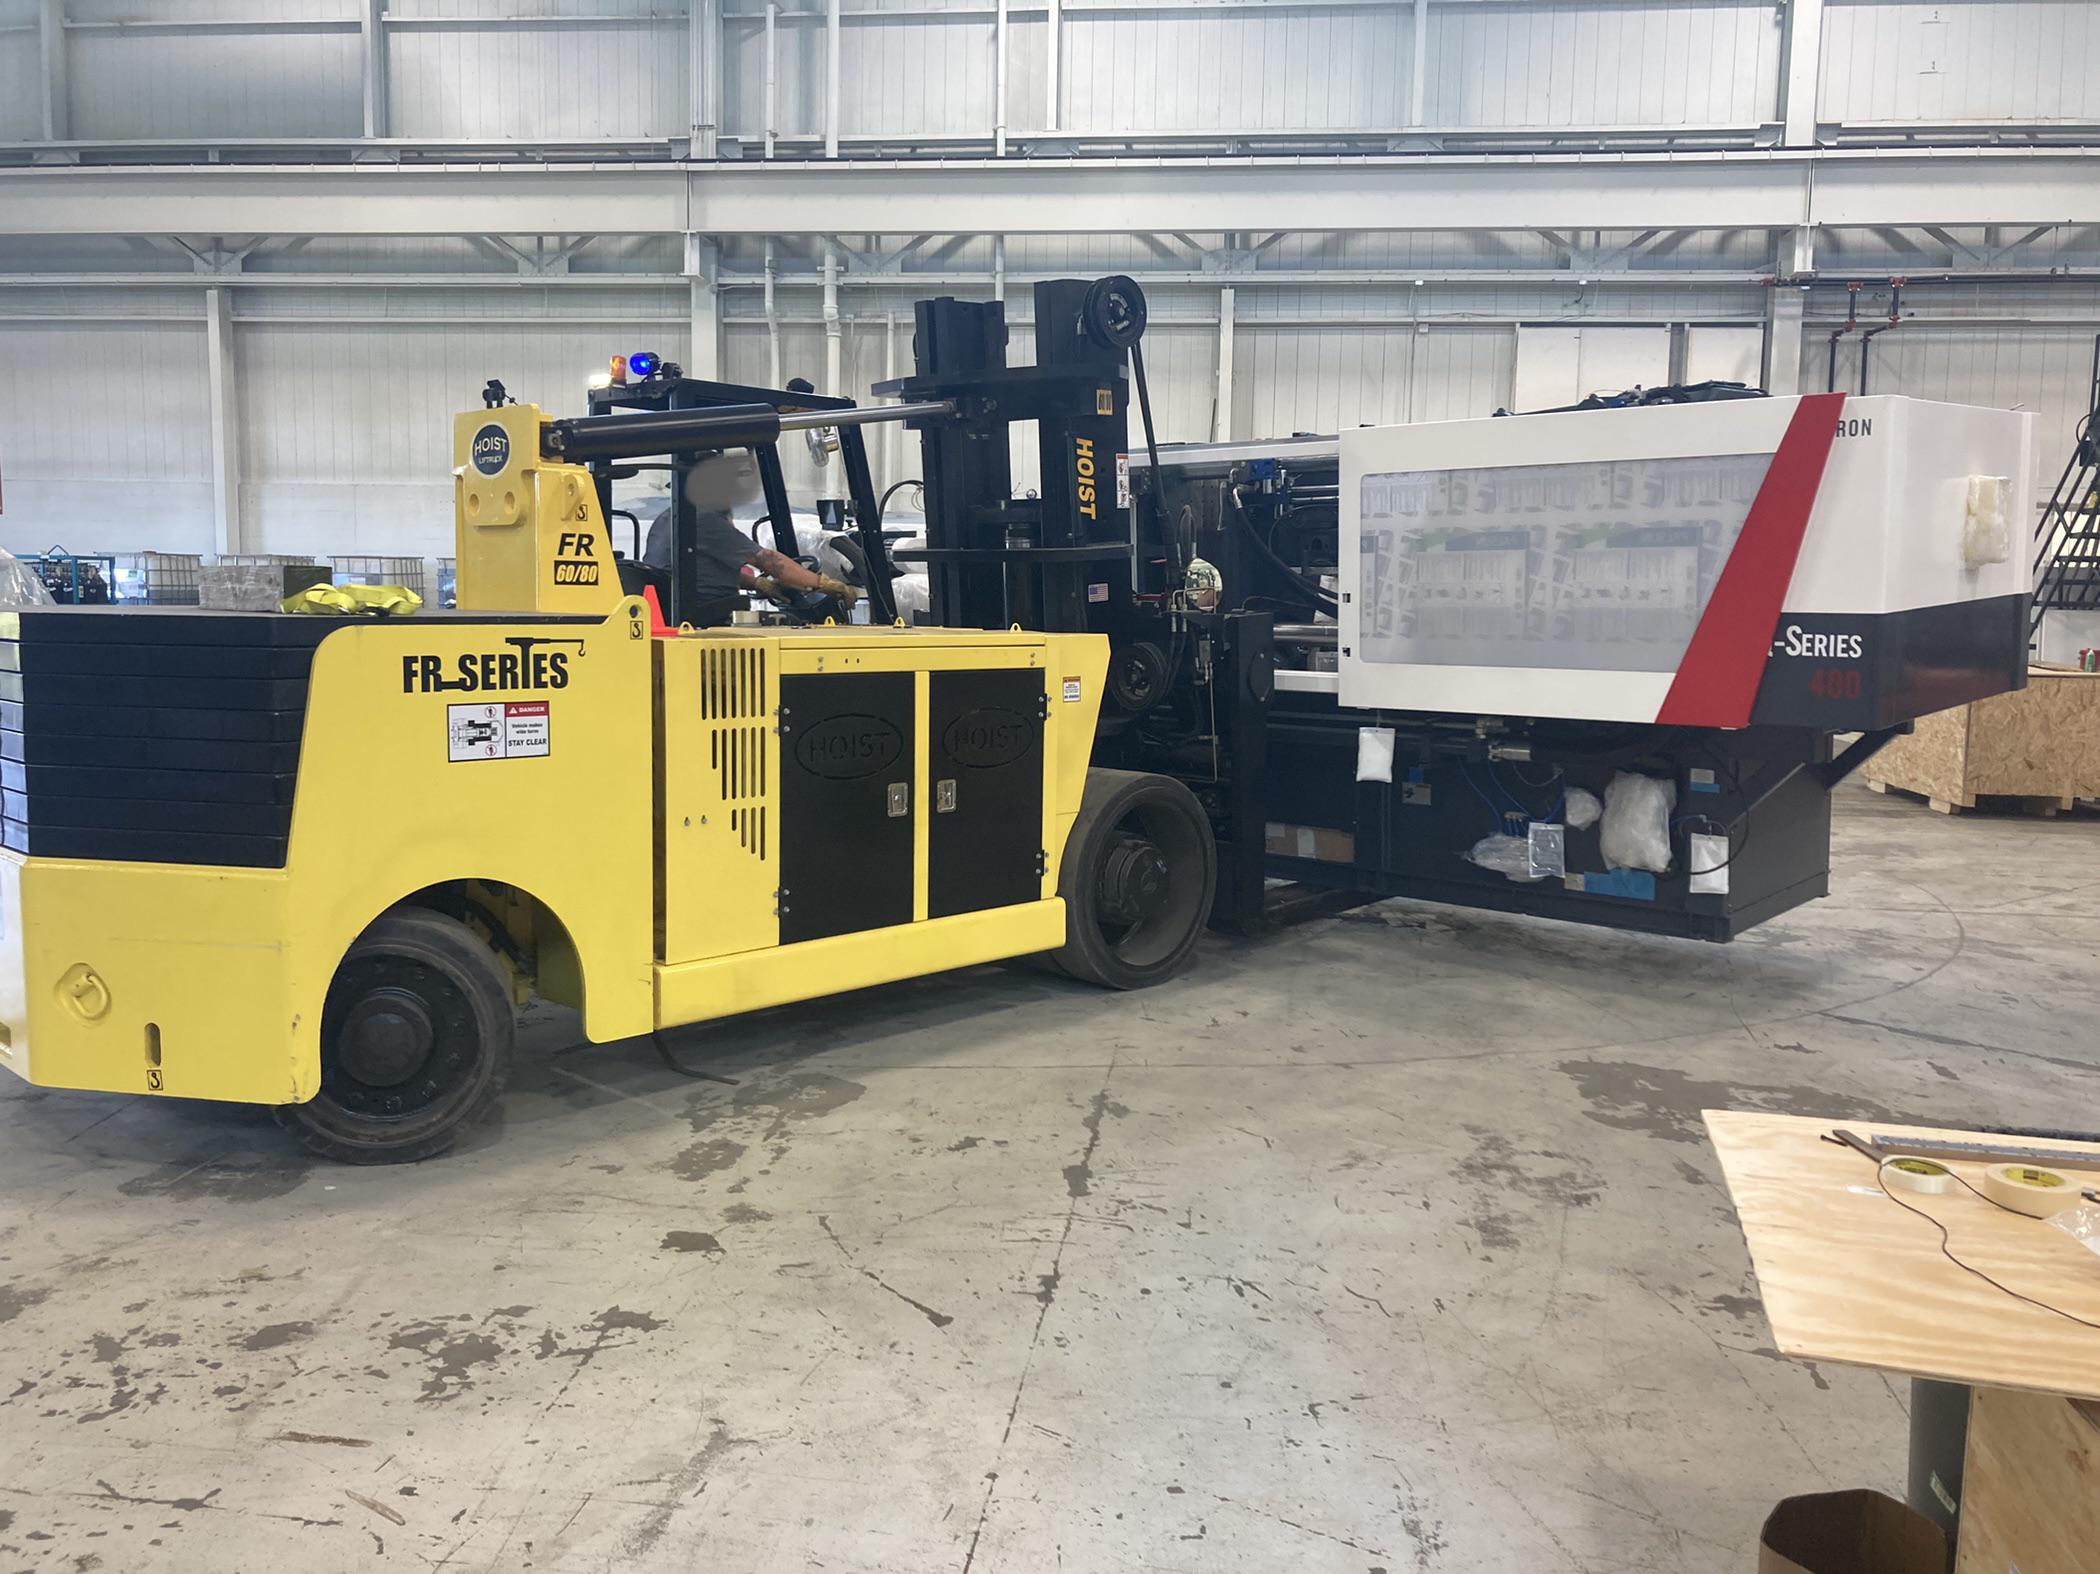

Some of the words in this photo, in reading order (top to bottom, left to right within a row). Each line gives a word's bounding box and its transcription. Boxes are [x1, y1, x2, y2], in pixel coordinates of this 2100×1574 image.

[474, 437, 508, 457] HOIST
[1075, 437, 1097, 521] HOIST
[556, 532, 596, 557] FR
[555, 564, 598, 584] 60/80
[1768, 624, 1863, 659] -SERIES
[508, 739, 525, 747] STAY
[526, 738, 547, 746] CLEAR
[809, 731, 891, 762] HOIST
[954, 724, 1023, 752] HOIST
